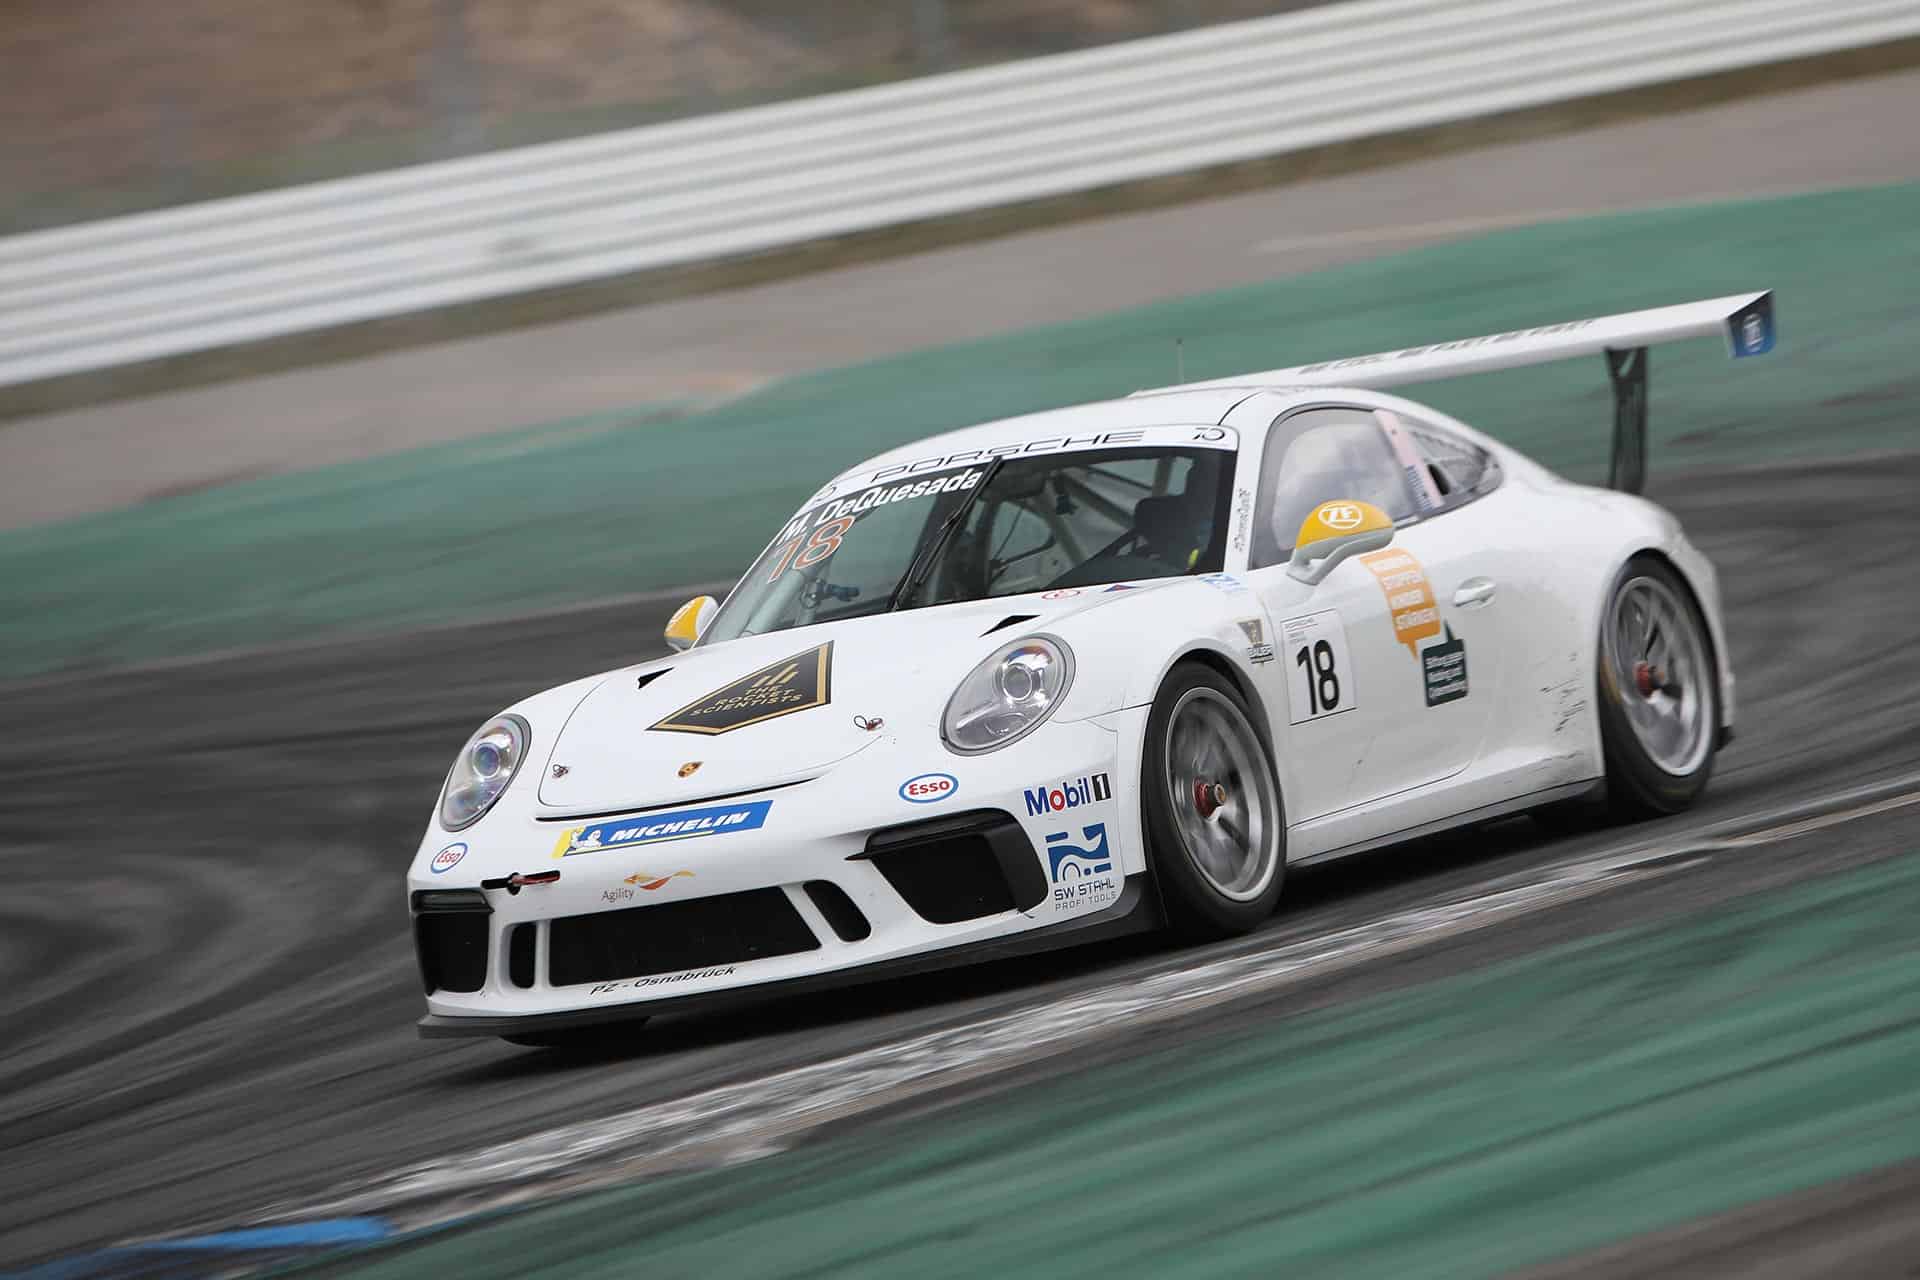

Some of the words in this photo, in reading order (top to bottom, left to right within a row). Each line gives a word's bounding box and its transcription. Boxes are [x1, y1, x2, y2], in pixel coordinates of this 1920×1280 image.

[871, 430, 1145, 483] PORSCHE
[777, 512, 812, 546] M.
[814, 468, 984, 527] DeQuesada
[766, 515, 855, 584] 18
[1296, 640, 1339, 714] 18
[689, 694, 802, 716] SCIENTISTS
[714, 688, 795, 705] ROCKET
[1023, 777, 1092, 816] Mobil
[1093, 773, 1111, 801] 1
[608, 811, 751, 842] MICHELIN
[601, 887, 634, 903] Agility
[1054, 886, 1075, 901] SW
[1078, 878, 1115, 896] STAHL
[1055, 896, 1085, 911] PROFI
[1088, 890, 1116, 906] TOOLS
[590, 983, 617, 996] PZ
[634, 964, 737, 988] Osnabrück
